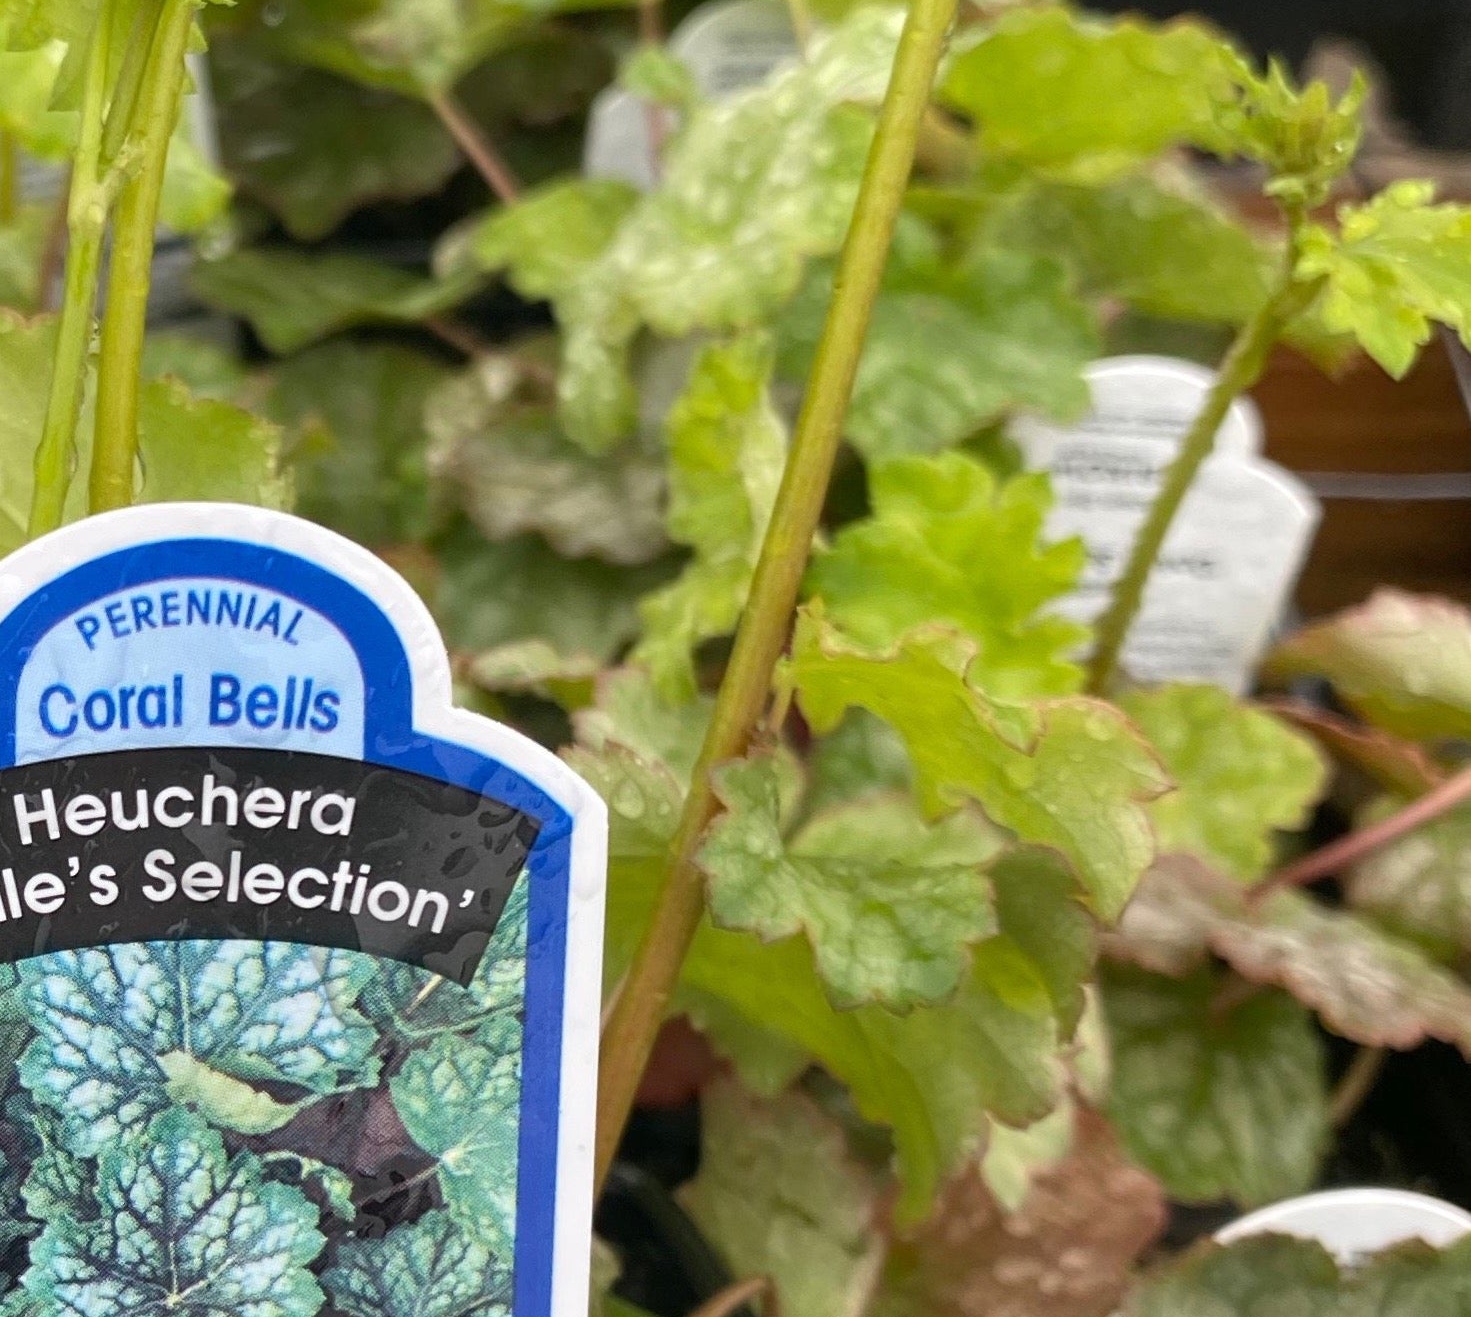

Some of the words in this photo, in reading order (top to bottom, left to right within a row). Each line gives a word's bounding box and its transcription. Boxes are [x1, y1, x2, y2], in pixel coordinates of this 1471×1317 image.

[74, 587, 304, 651] PERENNIAL
[37, 672, 184, 740] Coral
[208, 671, 341, 733] Bells
[12, 773, 356, 846] Heuchera
[141, 847, 475, 935] Selection’
